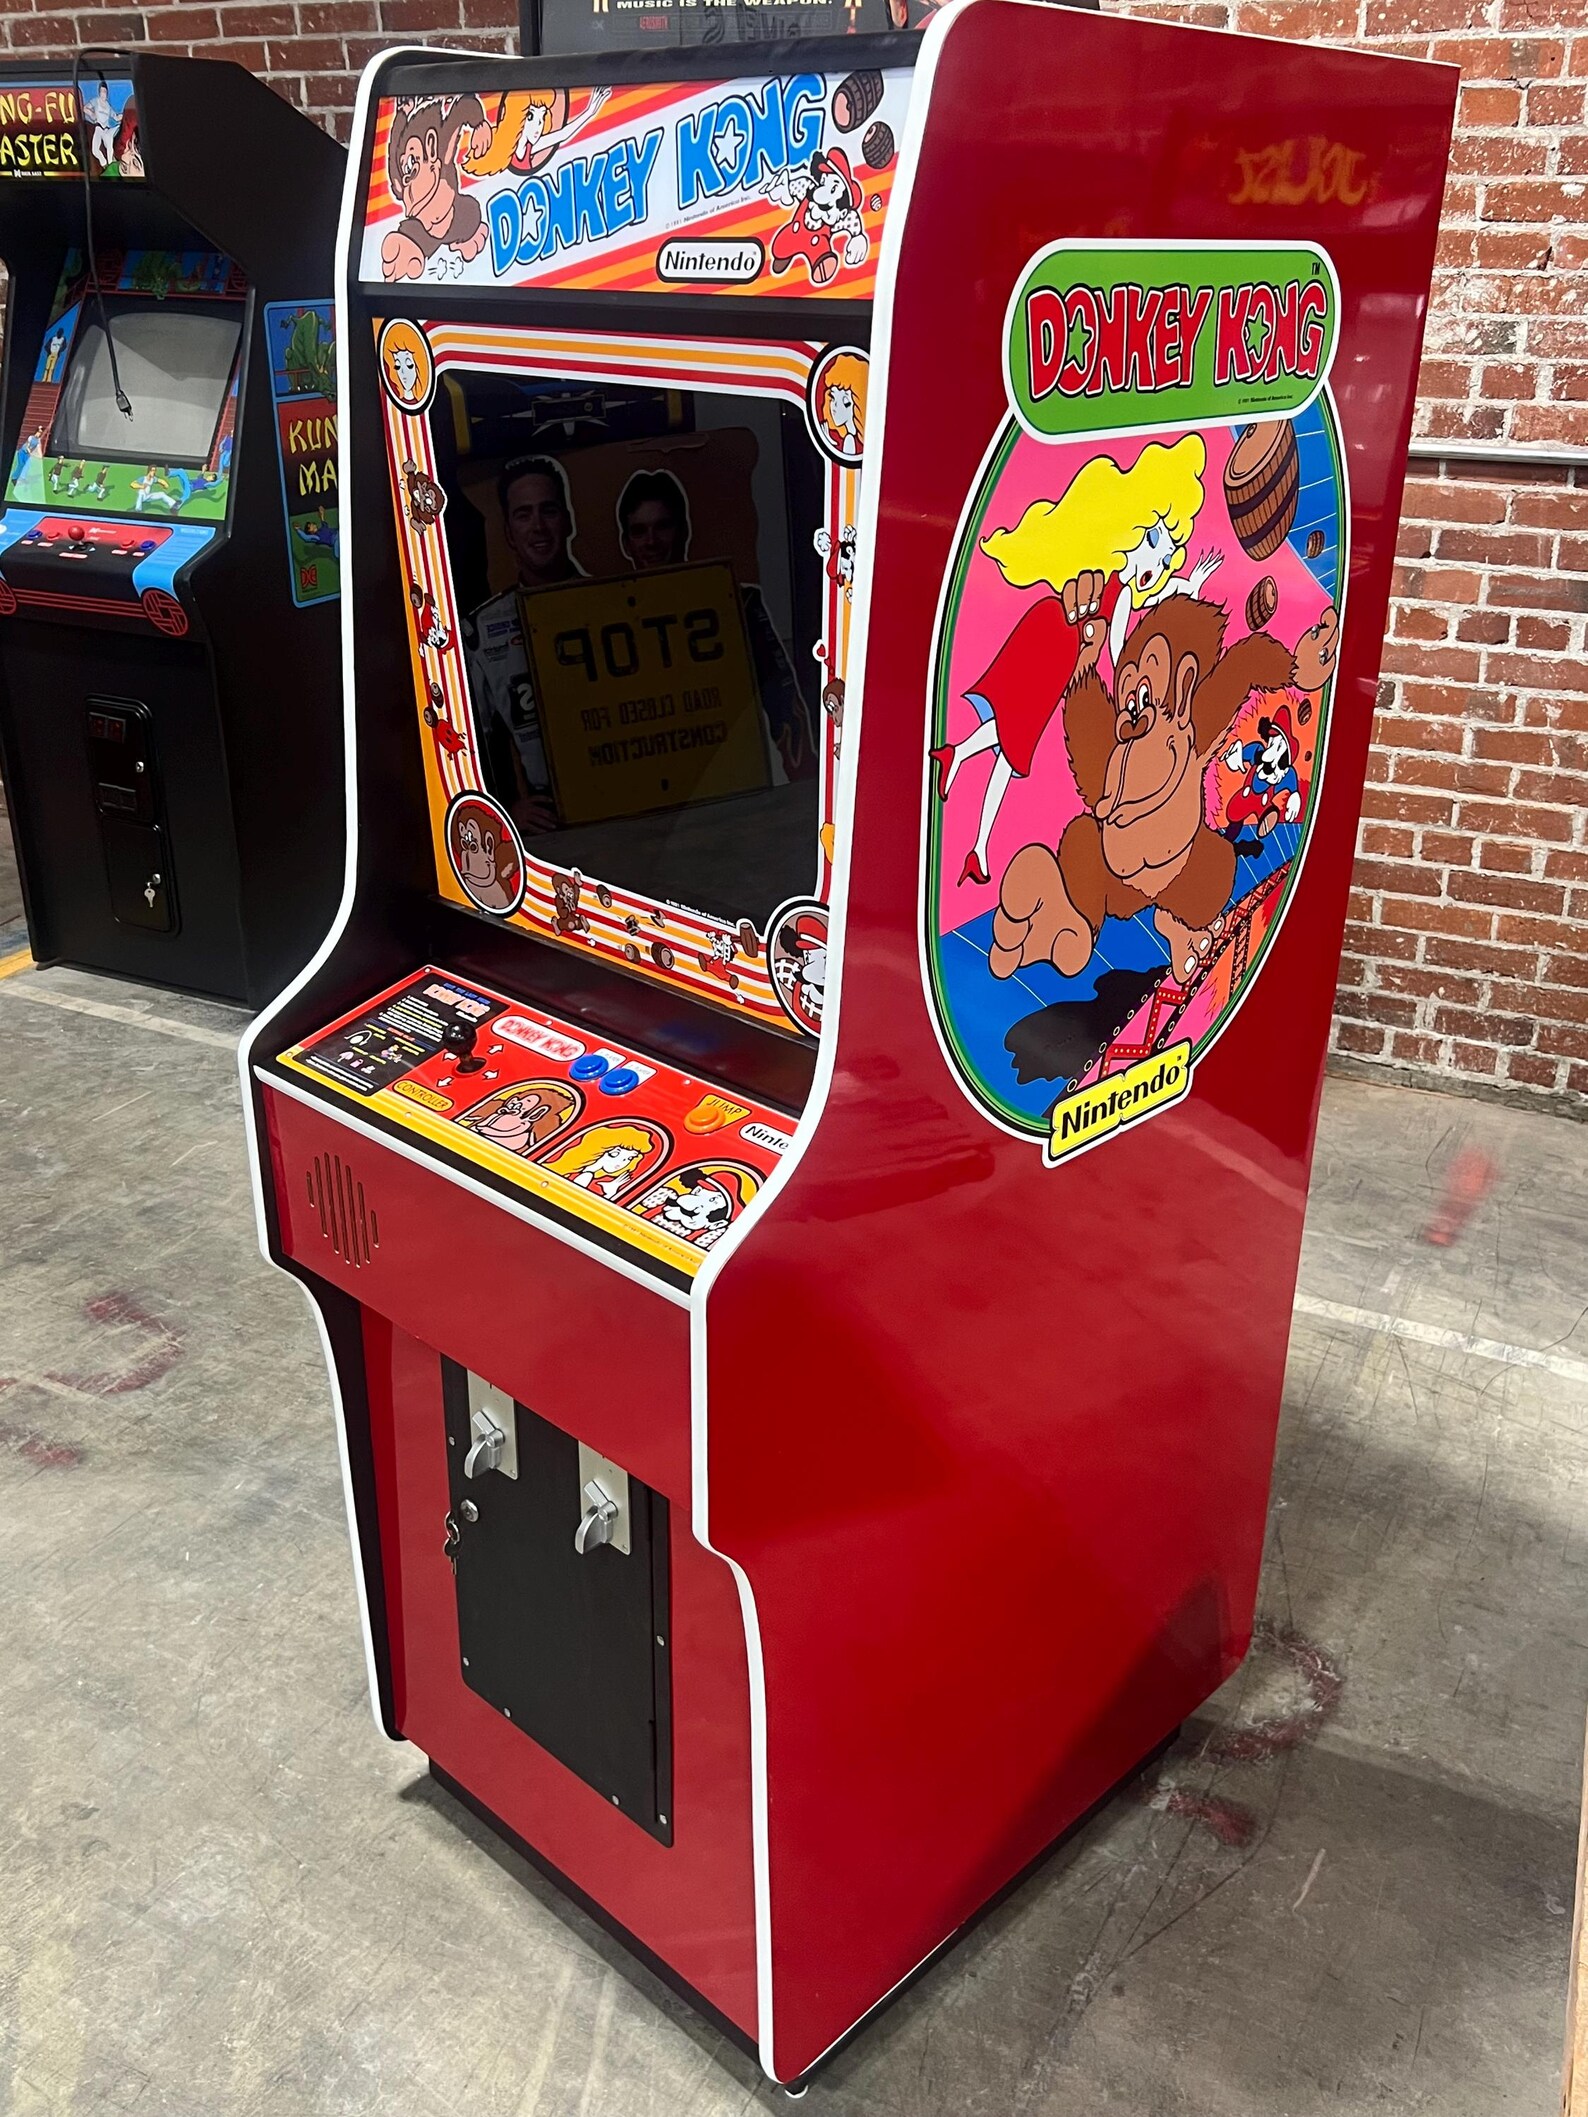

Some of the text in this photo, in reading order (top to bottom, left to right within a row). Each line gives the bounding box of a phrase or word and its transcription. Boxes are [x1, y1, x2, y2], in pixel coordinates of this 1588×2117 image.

[617, 0, 673, 9] MUSIC
[487, 72, 827, 278] DONKEY KONG
[664, 250, 756, 272] Nintendo
[1025, 283, 1213, 402] DONKEY
[1213, 279, 1328, 387] KONG
[396, 1081, 449, 1109] CONTROLLER
[1061, 1063, 1180, 1141] Nintendo
